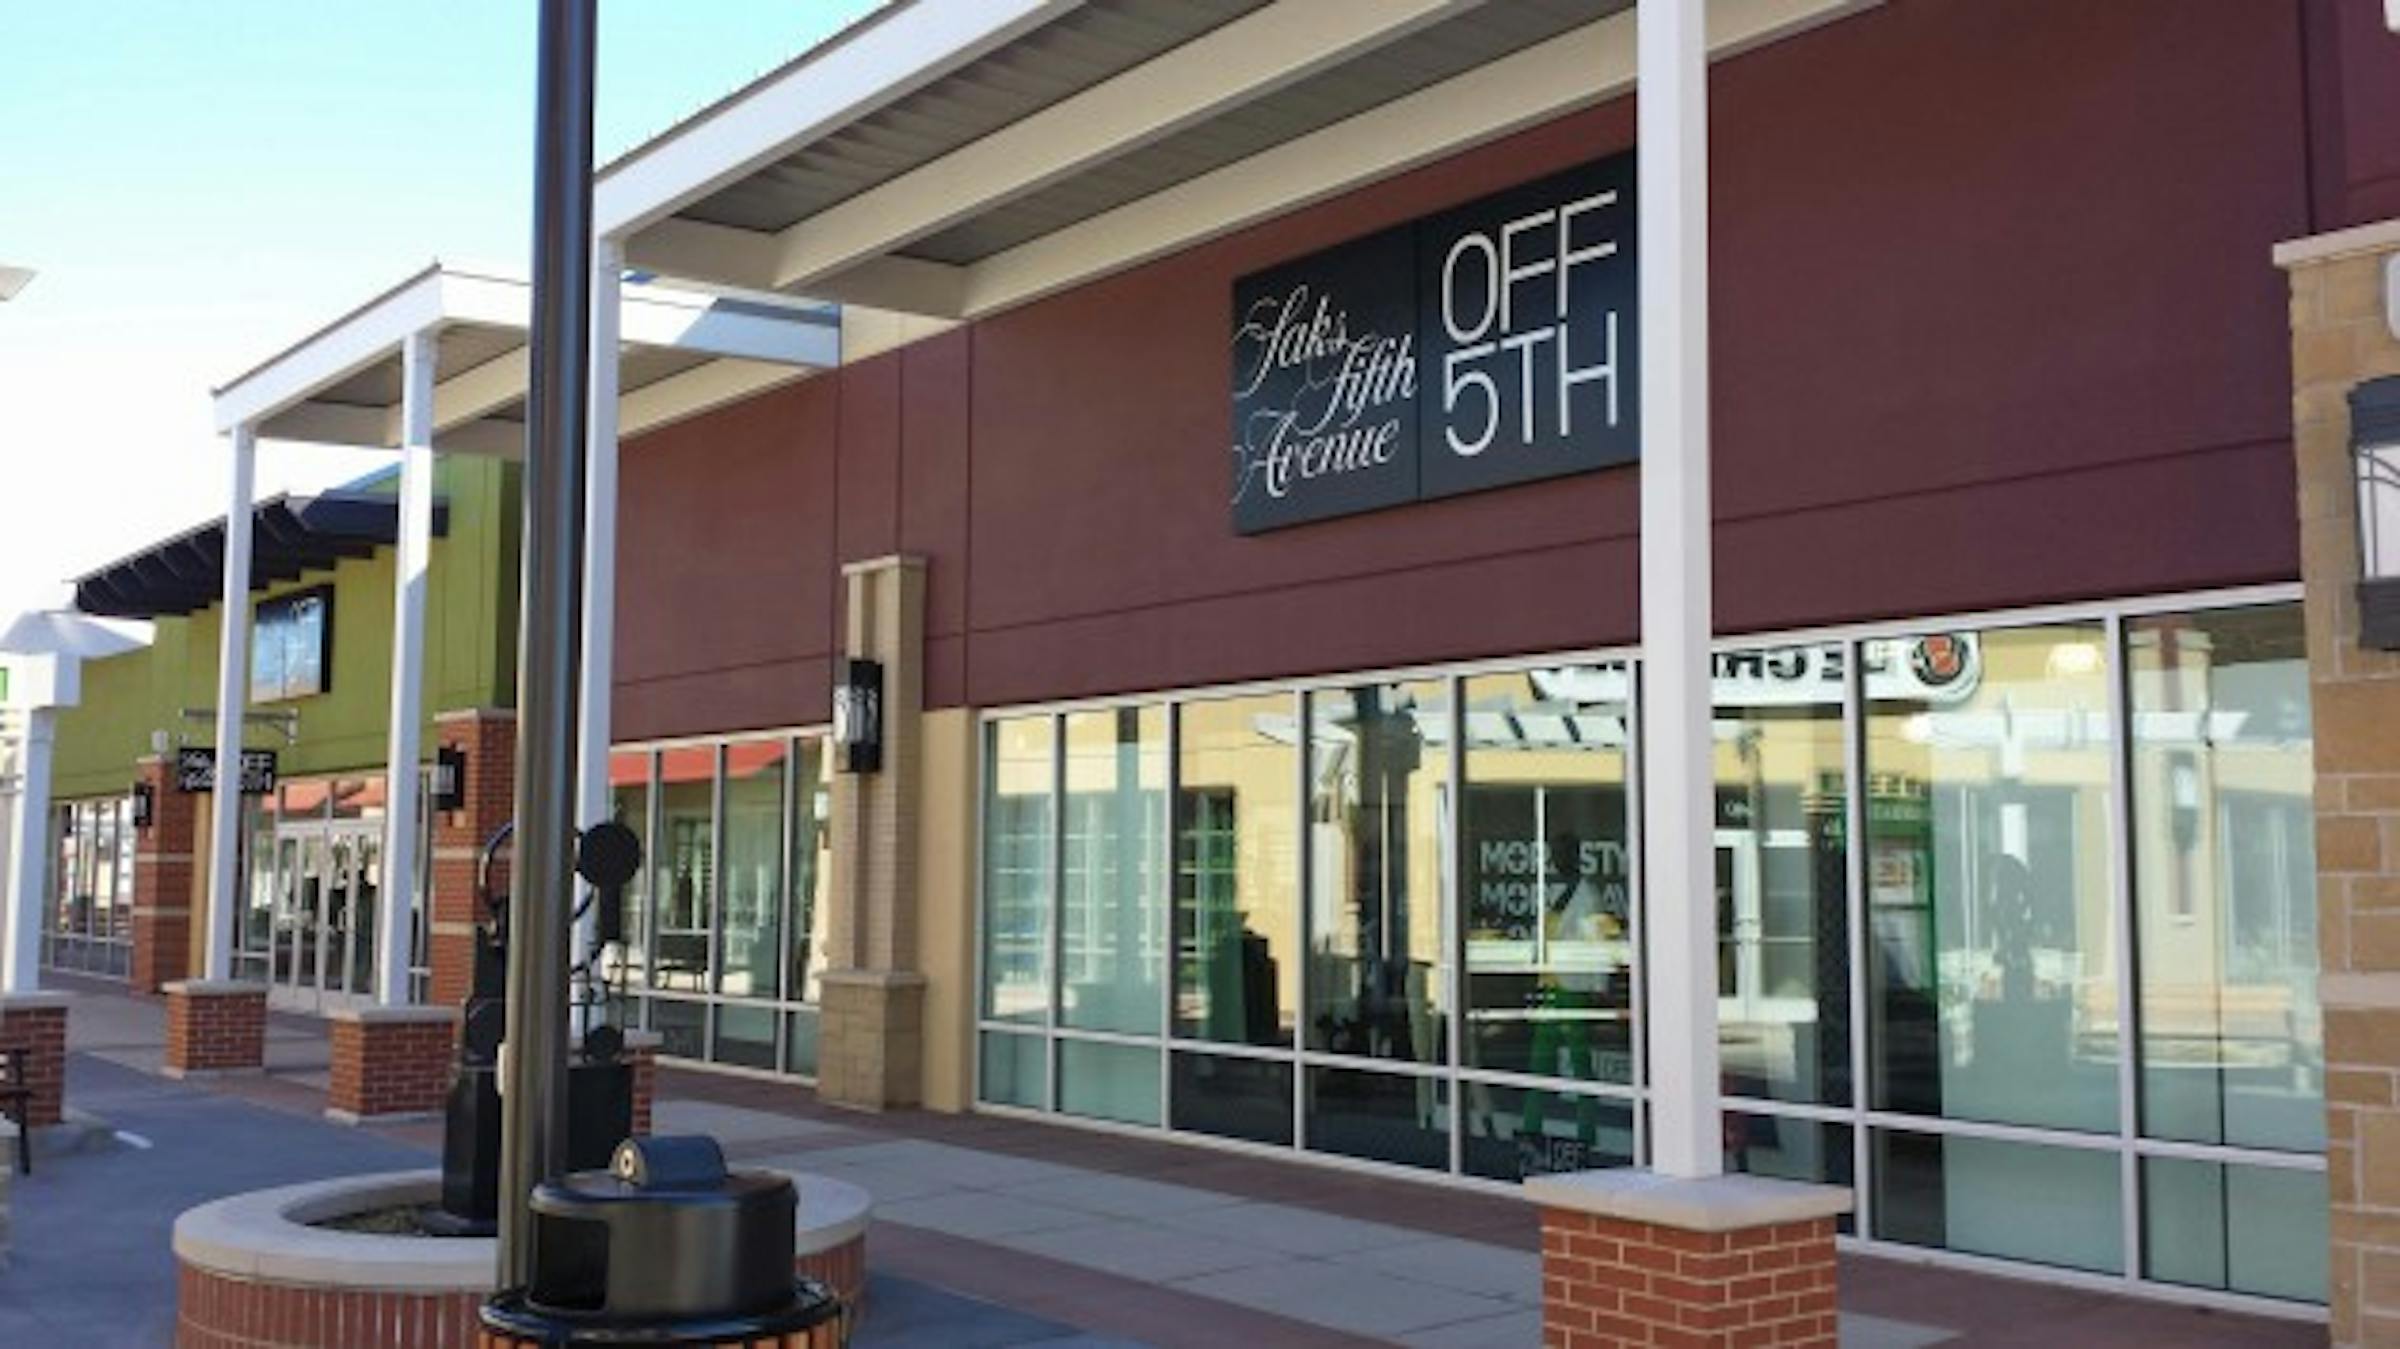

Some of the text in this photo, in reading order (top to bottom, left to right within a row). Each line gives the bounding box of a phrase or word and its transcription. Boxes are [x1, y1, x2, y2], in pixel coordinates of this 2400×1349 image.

[1441, 189, 1618, 344] OFF
[1232, 283, 1350, 399] Saks
[1292, 332, 1418, 436] Fifth
[1444, 311, 1618, 456] 5TH
[1233, 410, 1400, 502] Avenue
[1480, 840, 1559, 875] MOR
